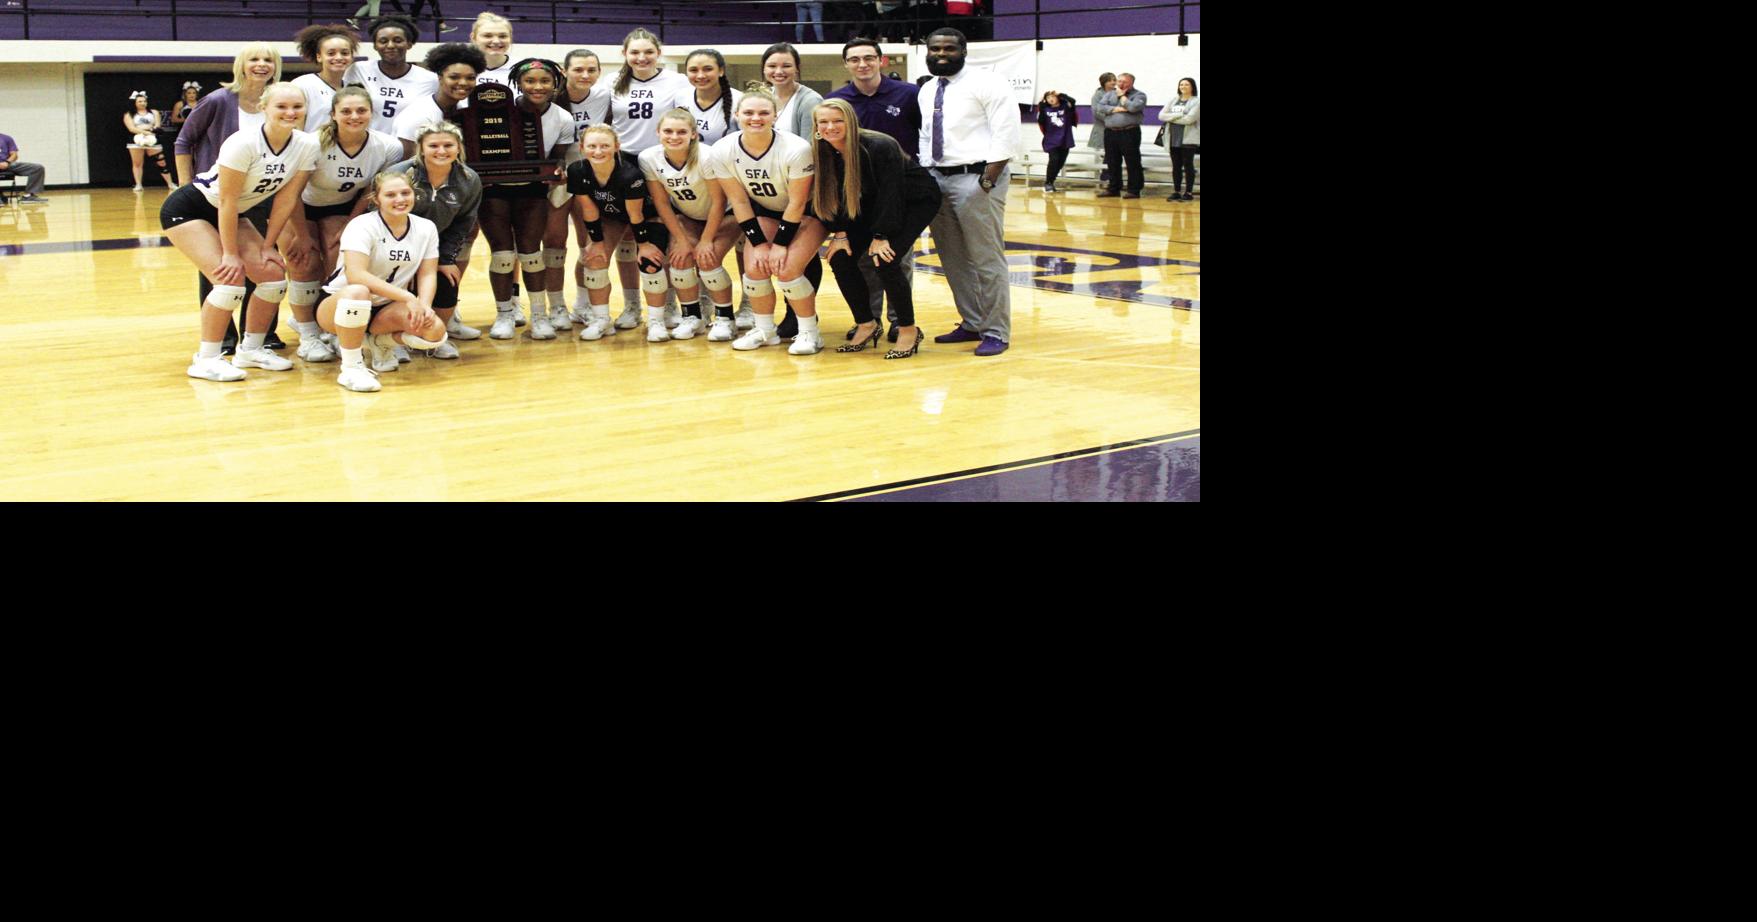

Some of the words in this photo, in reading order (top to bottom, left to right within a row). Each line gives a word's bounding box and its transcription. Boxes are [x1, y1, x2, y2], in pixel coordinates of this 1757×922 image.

[380, 86, 404, 99] SFA
[631, 89, 654, 99] SFA
[382, 99, 398, 118] 5
[628, 101, 654, 119] 28
[573, 110, 591, 122] FA
[696, 119, 710, 131] FA
[265, 163, 286, 174] SFA
[338, 166, 364, 178] SFA
[745, 168, 770, 179] SFA
[666, 176, 690, 187] SFA
[673, 188, 697, 201] 18
[748, 182, 778, 197] 20
[389, 249, 411, 261] SFA
[385, 264, 400, 284] 1
